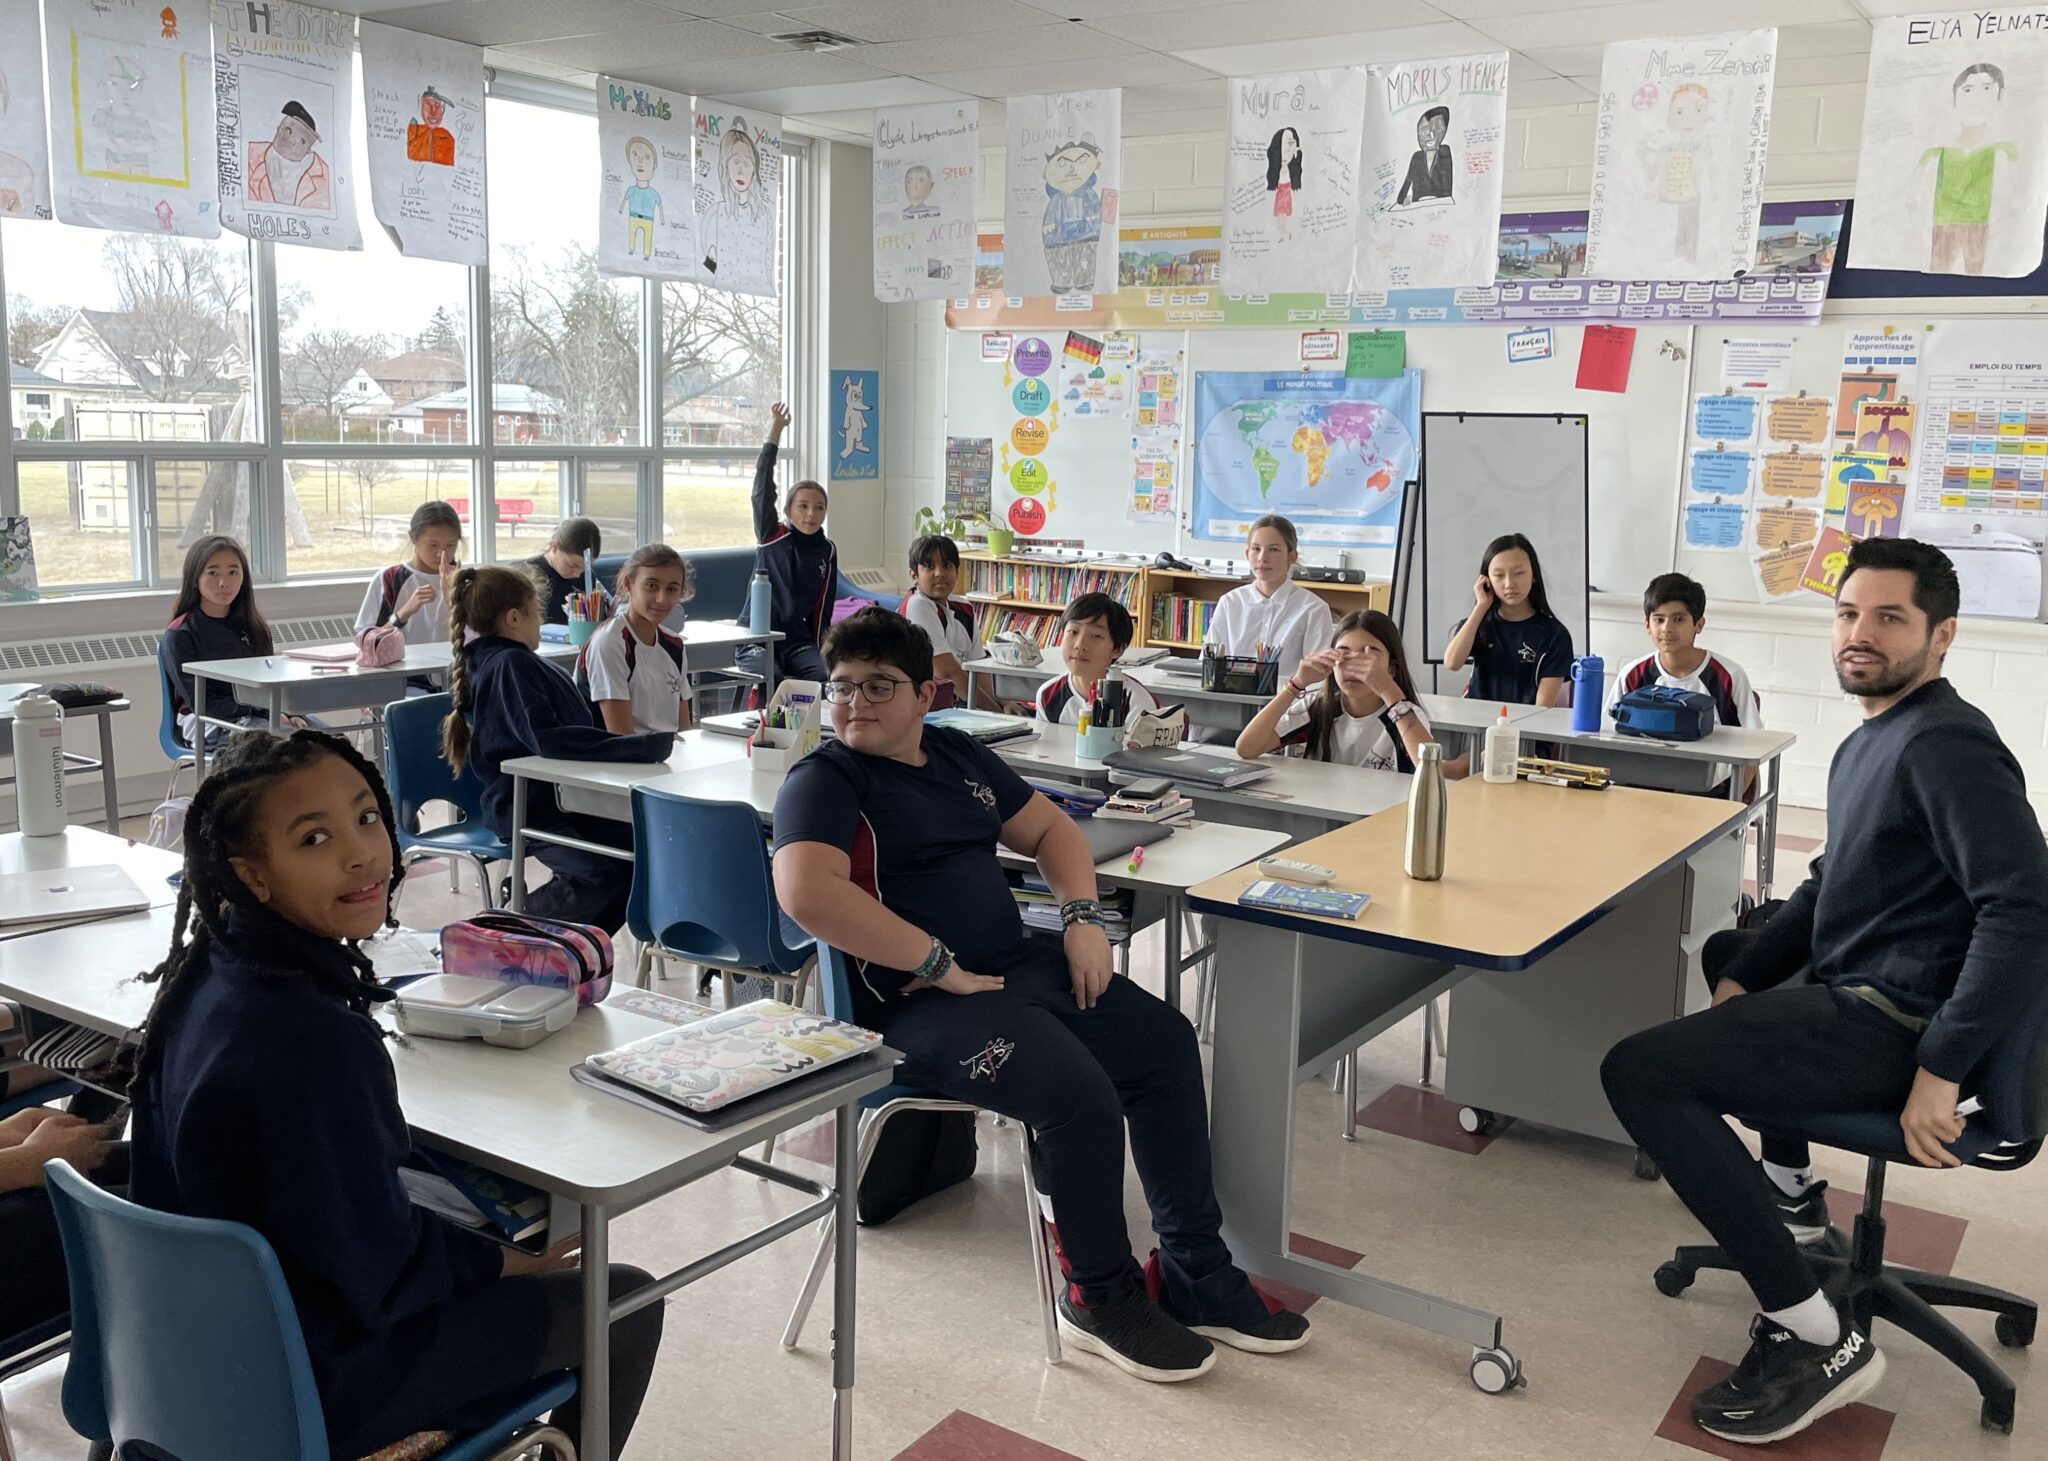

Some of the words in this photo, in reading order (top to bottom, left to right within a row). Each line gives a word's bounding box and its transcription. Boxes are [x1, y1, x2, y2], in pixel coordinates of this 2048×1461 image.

[216, 0, 345, 49] THEODORE
[1908, 17, 1962, 45] ELYA
[1645, 49, 1696, 78] Mme
[1699, 50, 1773, 76] Zeroni
[1387, 67, 1451, 113] MORRIS
[1241, 84, 1305, 118] Myra
[695, 113, 724, 137] MRS
[1021, 126, 1077, 148] DUNNE
[247, 213, 312, 240] HOLES
[1512, 337, 1546, 349] FRANÇAIS
[1853, 334, 1900, 343] Approches
[1902, 333, 1913, 342] de
[1849, 342, 1915, 351] l'apprentissage
[1016, 349, 1049, 359] Prewrite
[2015, 363, 2042, 371] TEMPS
[1277, 380, 1286, 388] LE
[1306, 380, 1334, 388] POLITIQUE
[1020, 390, 1043, 401] Draft
[1864, 406, 1910, 417] SOCIAL
[1016, 428, 1045, 439] Revise
[1021, 468, 1037, 478] Edit
[1012, 508, 1042, 520] Publish
[52, 746, 63, 808] lululemon
[1822, 1330, 1865, 1379] HOKA
